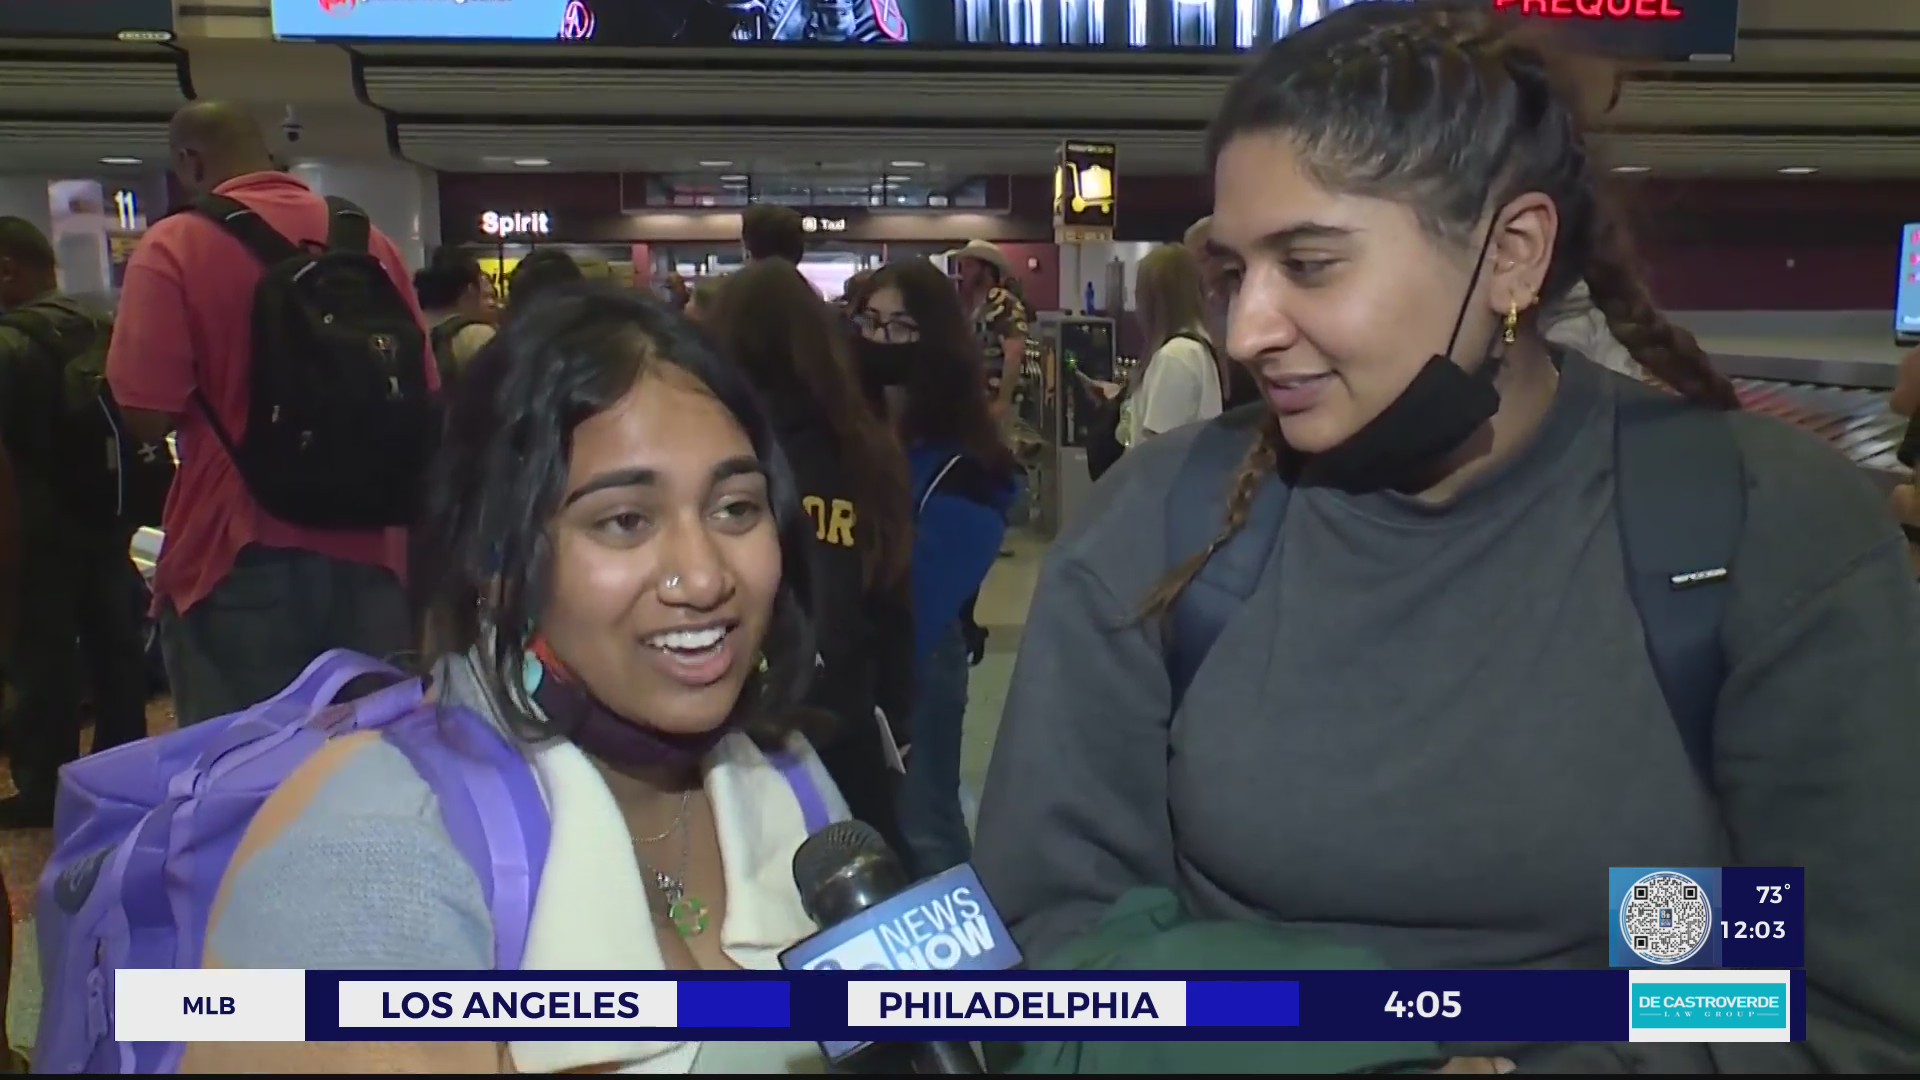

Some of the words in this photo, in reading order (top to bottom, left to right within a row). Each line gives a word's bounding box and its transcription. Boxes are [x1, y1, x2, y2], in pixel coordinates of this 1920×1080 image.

[1495, 0, 1682, 17] REQUEL
[114, 189, 135, 230] 11
[482, 210, 549, 238] Spirit
[878, 887, 980, 953] NEWS
[895, 914, 995, 970] NOW
